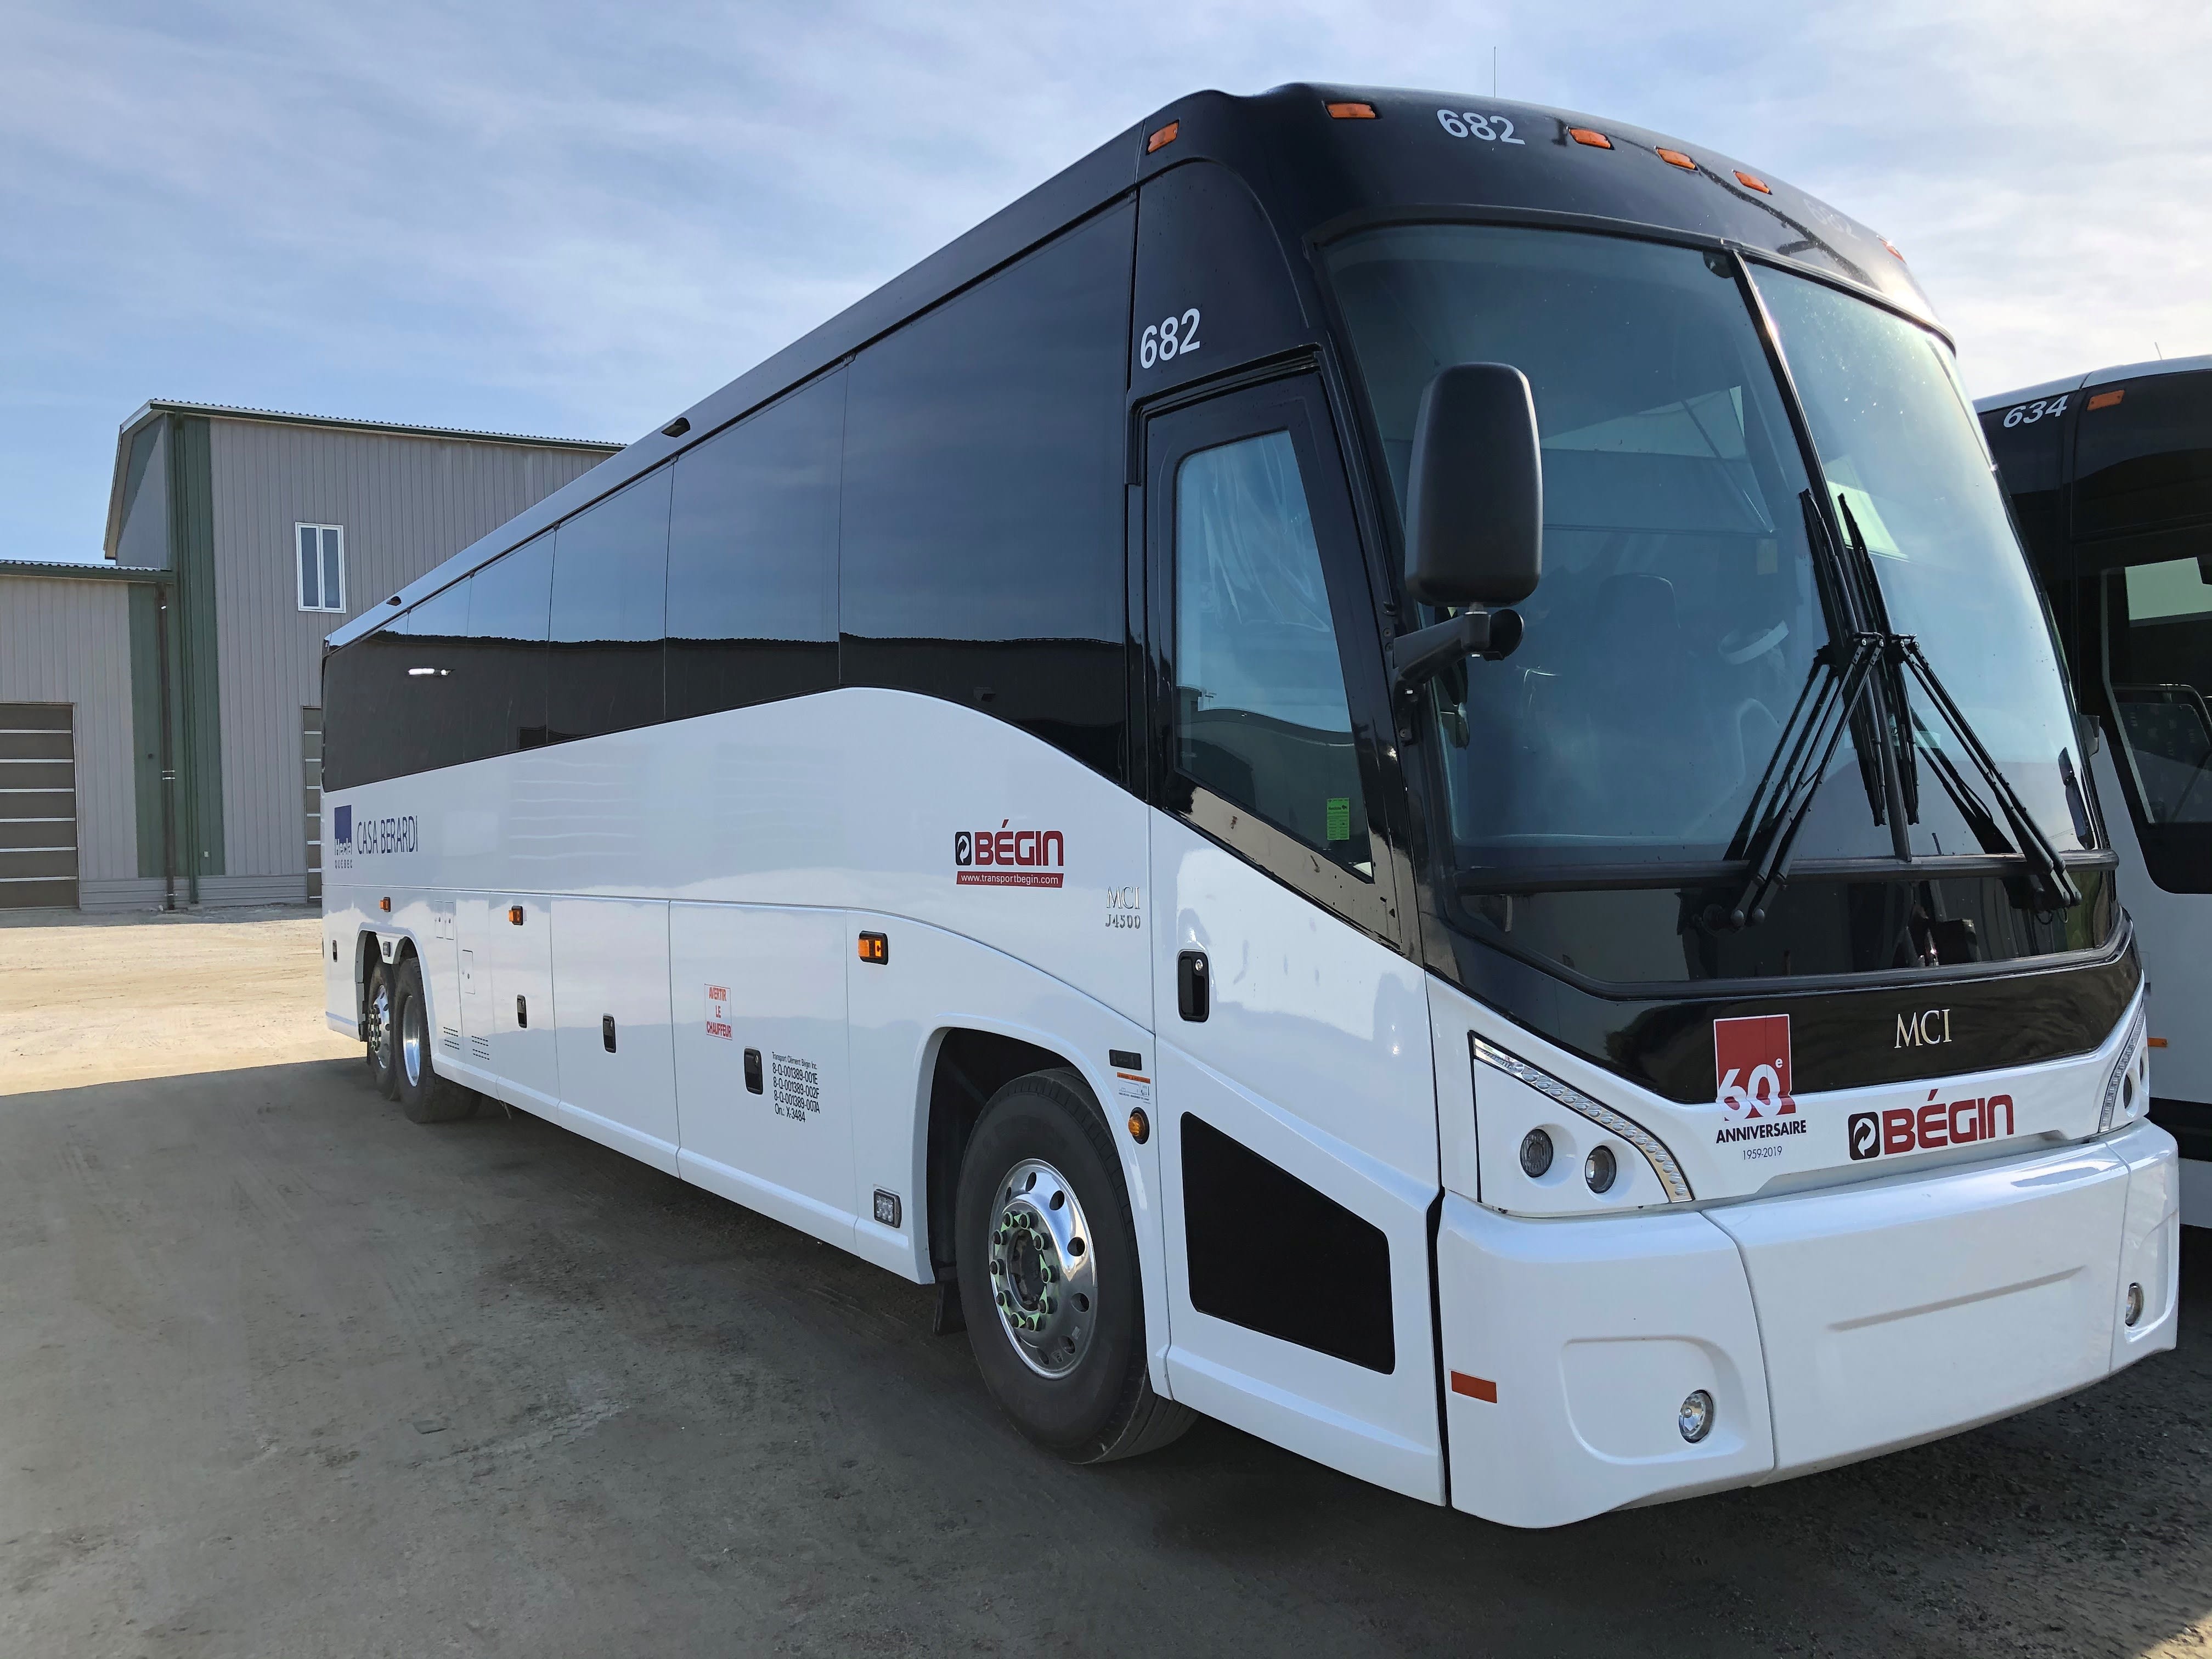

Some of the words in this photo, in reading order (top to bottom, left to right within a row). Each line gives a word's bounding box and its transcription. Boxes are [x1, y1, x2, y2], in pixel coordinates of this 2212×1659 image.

[1437, 109, 1526, 145] 682
[1141, 308, 1200, 369] 682
[2003, 395, 2069, 428] 634
[335, 837, 352, 856] Hecla
[357, 820, 379, 855] CASA
[381, 815, 418, 854] BERARDI
[974, 819, 1064, 867] BÉGIN
[961, 873, 1059, 885] www.transportbegin.com
[1106, 886, 1141, 910] MCI
[1105, 914, 1141, 929] J4500
[709, 986, 727, 1002] AVERTIR
[715, 1005, 721, 1018] LE
[707, 1020, 732, 1039] CHAUFFEUR
[1894, 1008, 1953, 1049] MCI
[771, 1051, 787, 1063] Transport
[772, 1062, 818, 1085] 8-Q-001389-001E
[773, 1076, 820, 1099] 8-Q-001389-002F
[774, 1090, 821, 1114] 8-Q-001389-007A
[786, 1105, 806, 1123] X-3484
[1882, 1088, 2015, 1155] BÉGIN
[1716, 1119, 1807, 1144] ANNIVERSAIRE
[1742, 1146, 1782, 1160] 1959-2019
